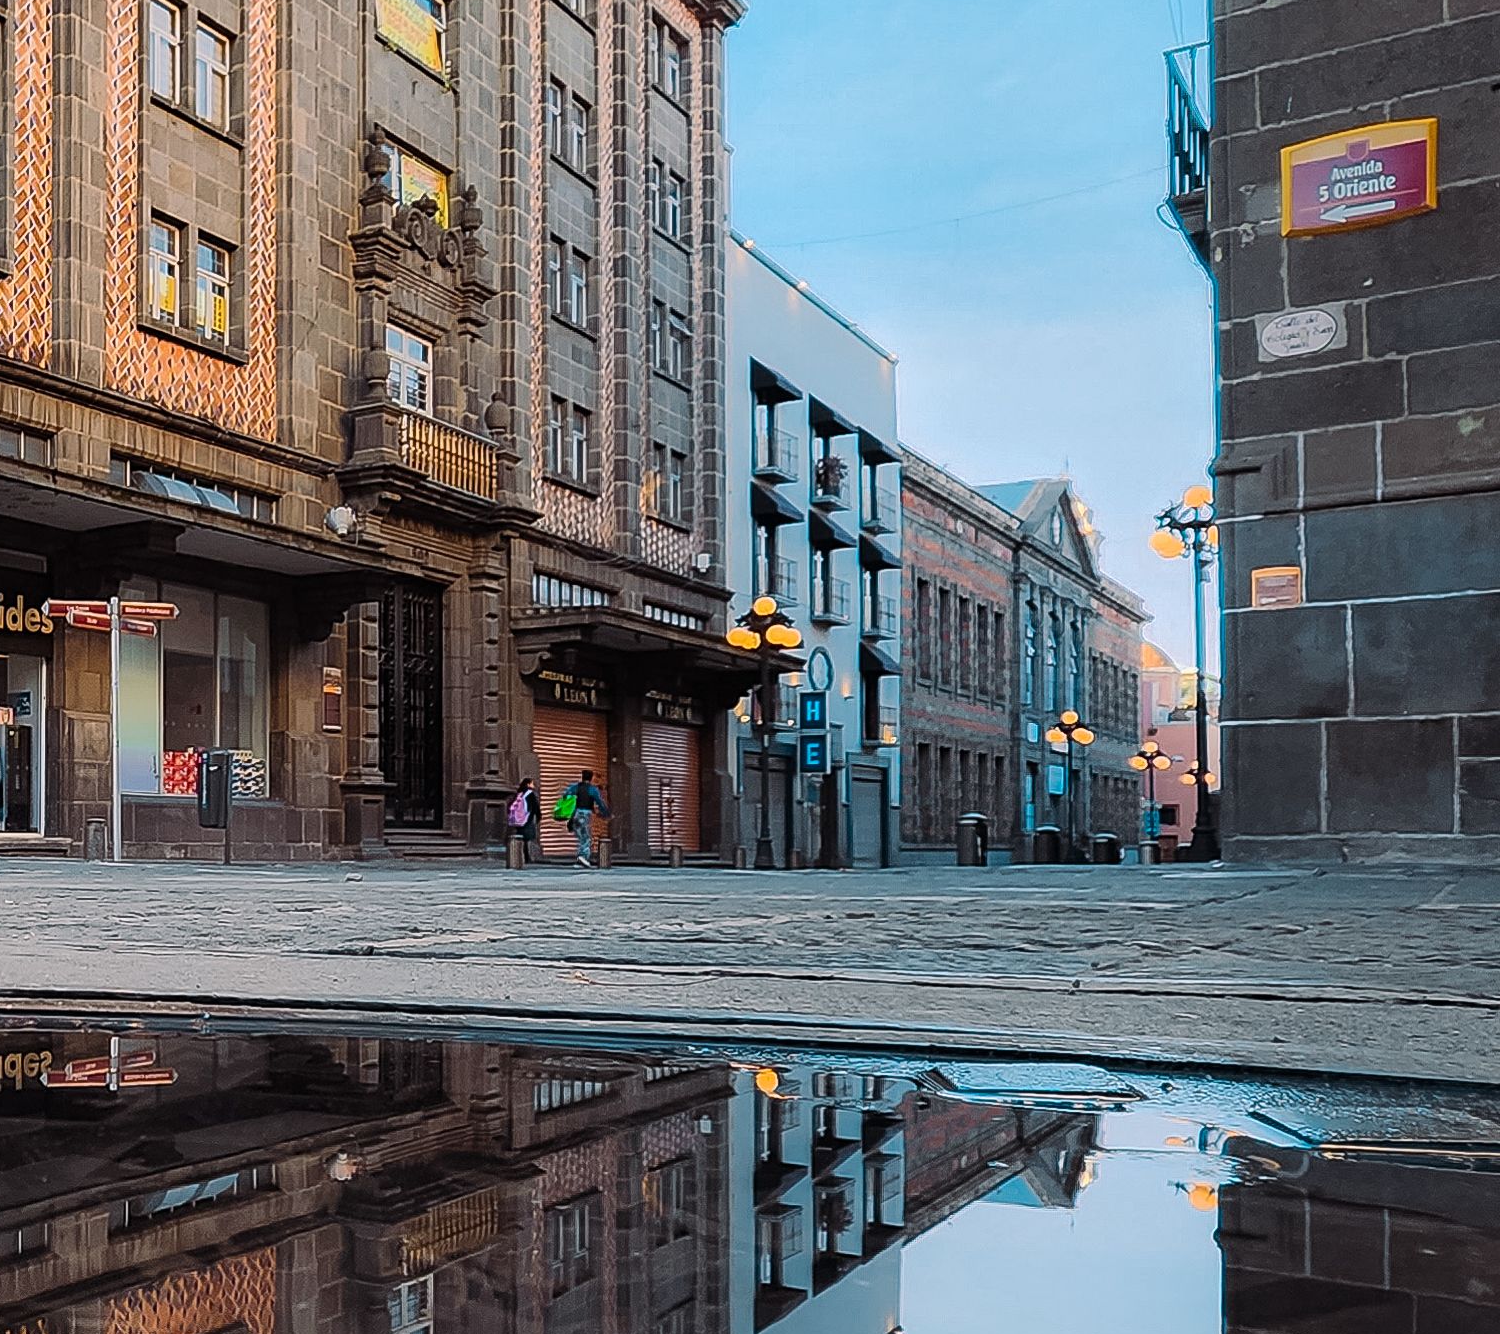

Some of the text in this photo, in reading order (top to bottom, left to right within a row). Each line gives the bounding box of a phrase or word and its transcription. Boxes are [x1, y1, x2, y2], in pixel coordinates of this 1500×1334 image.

[1331, 160, 1383, 182] Avenida
[1319, 174, 1397, 203] 5 Oriente
[806, 700, 820, 721] H
[806, 742, 820, 765] E
